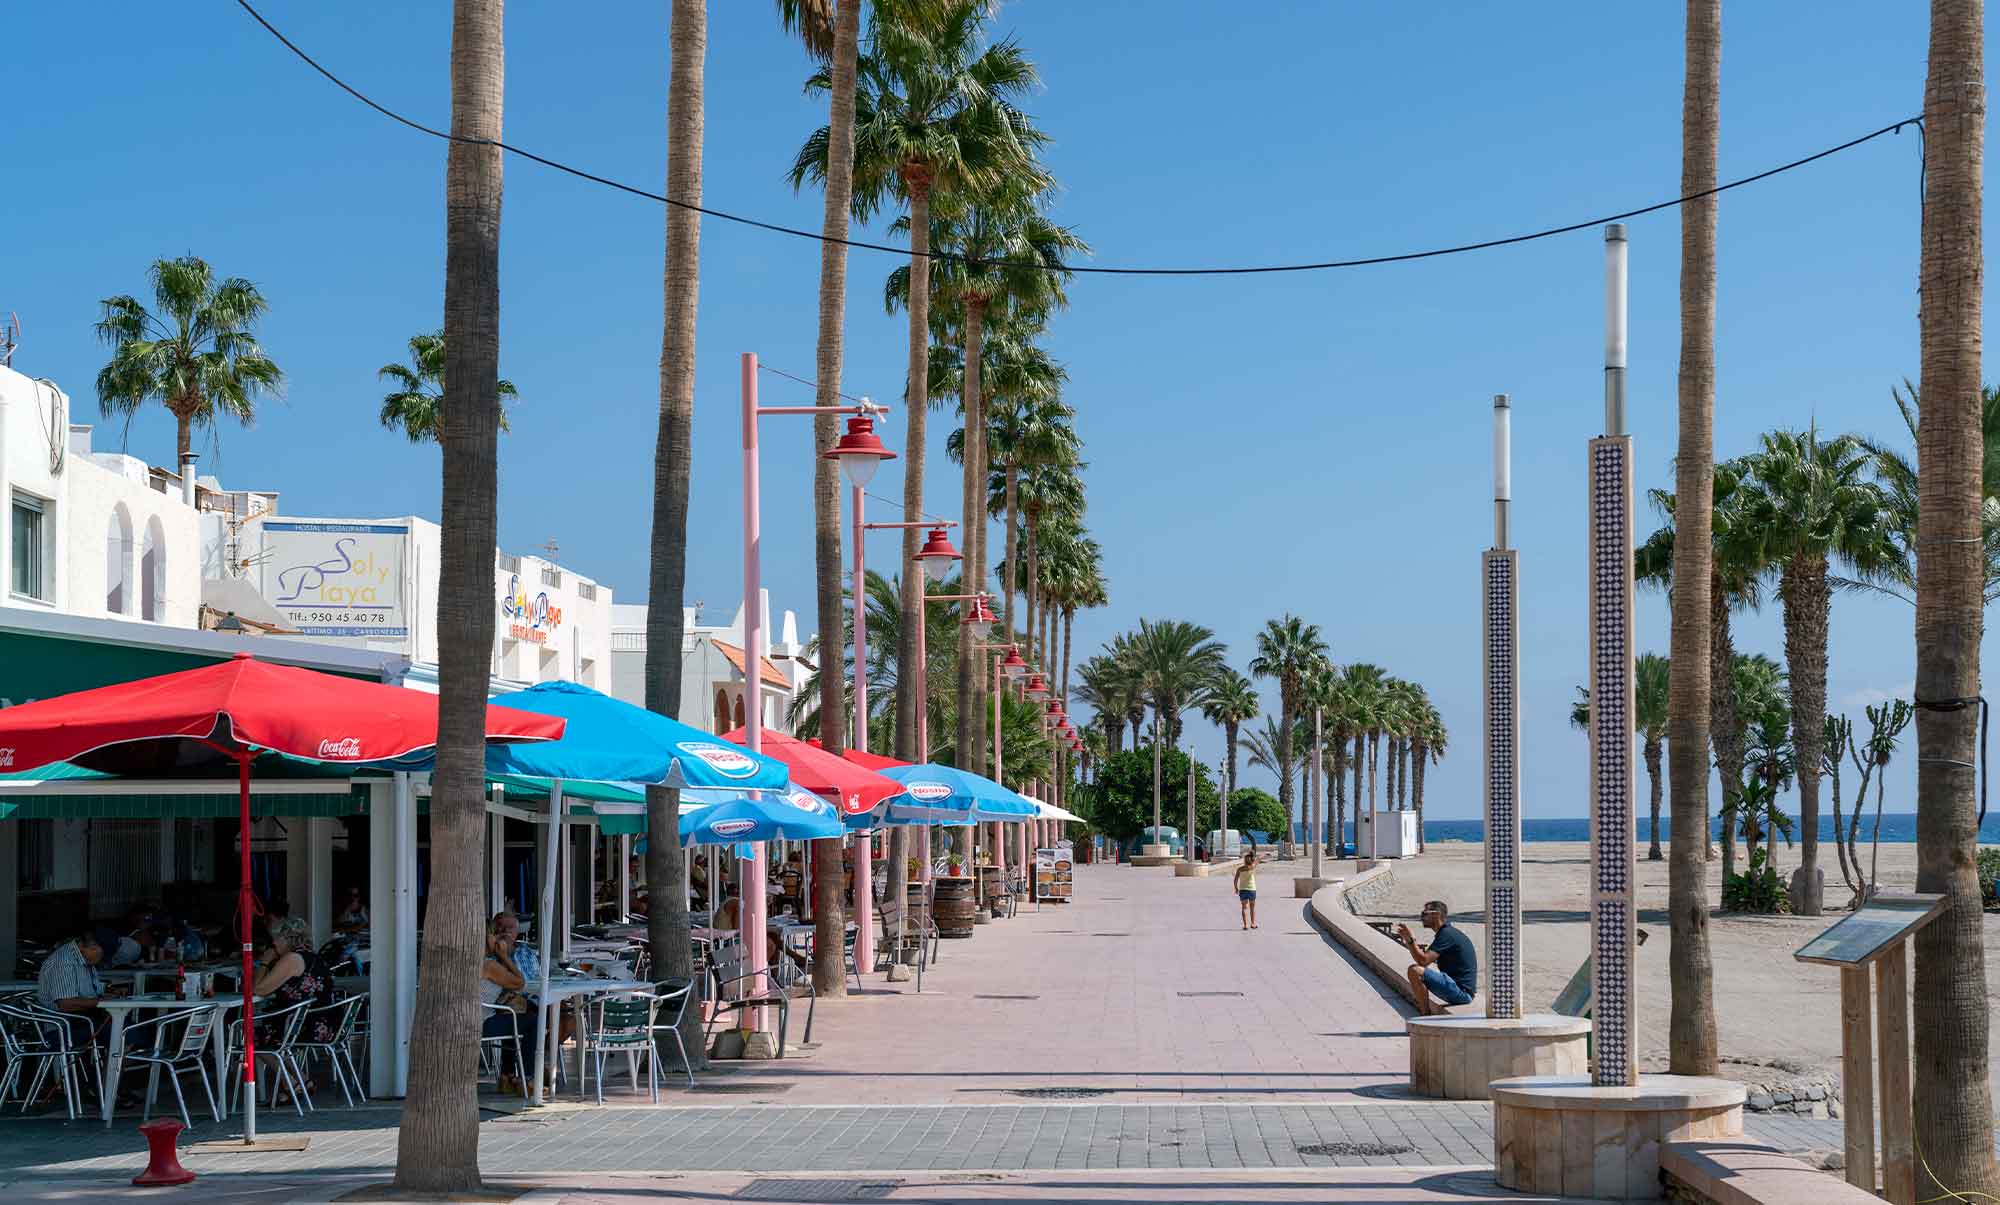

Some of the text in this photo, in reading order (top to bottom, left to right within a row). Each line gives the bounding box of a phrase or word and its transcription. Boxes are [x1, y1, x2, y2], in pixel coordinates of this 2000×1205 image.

[315, 537, 388, 584] Sol y
[277, 565, 377, 608] Playa
[311, 612, 332, 622] 950
[336, 613, 350, 622] 45
[354, 613, 367, 623] 40
[371, 613, 385, 623] 78
